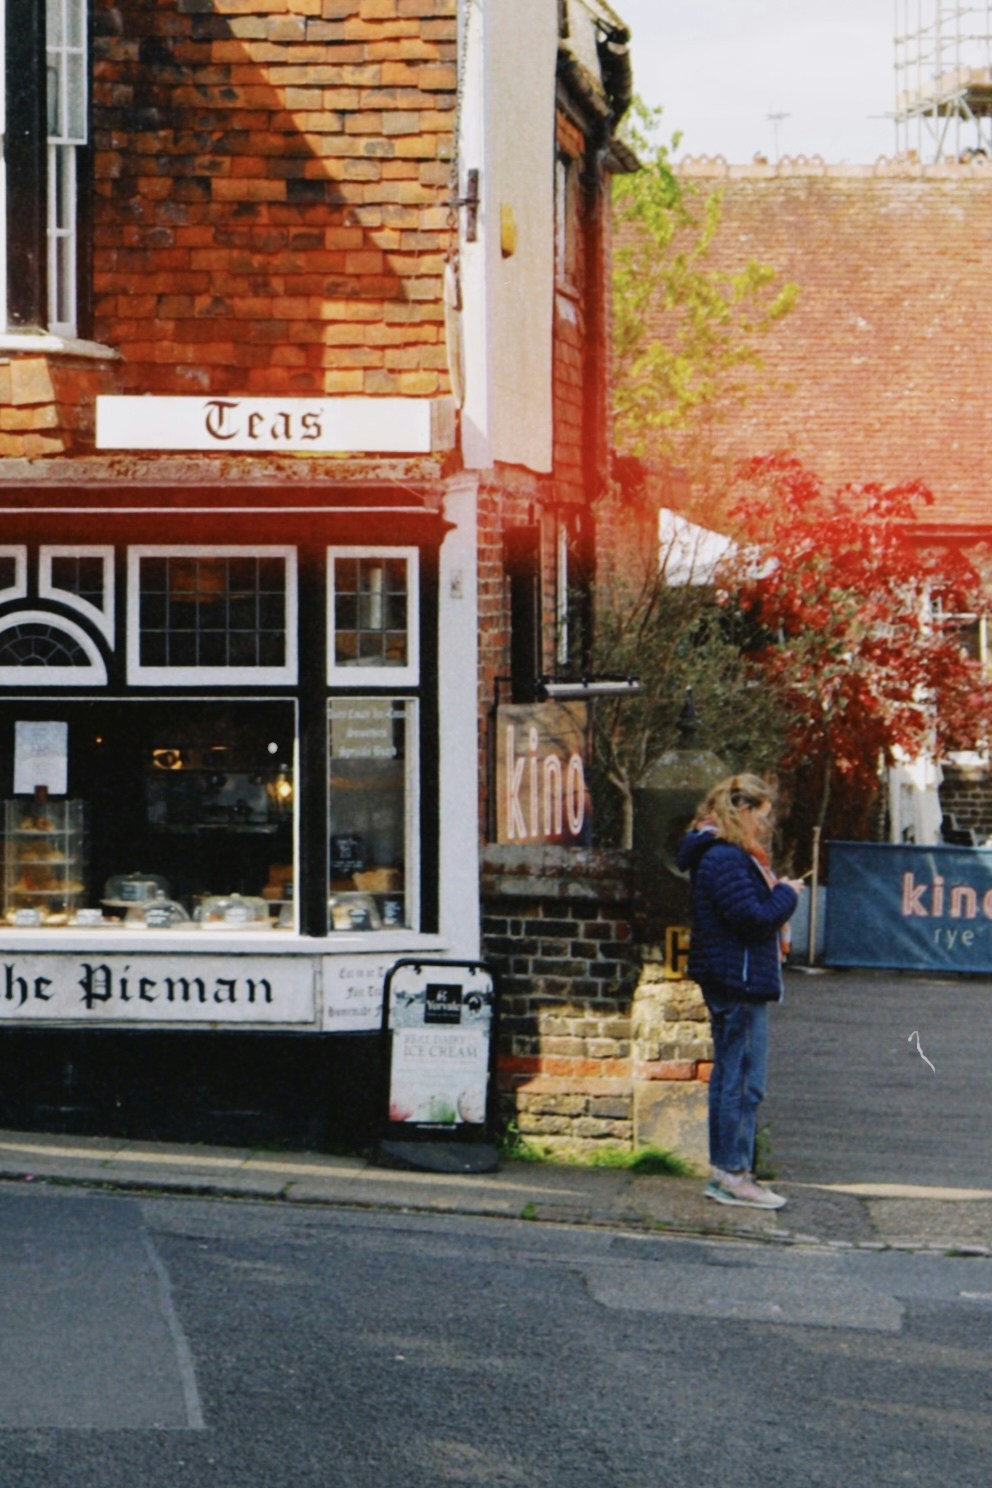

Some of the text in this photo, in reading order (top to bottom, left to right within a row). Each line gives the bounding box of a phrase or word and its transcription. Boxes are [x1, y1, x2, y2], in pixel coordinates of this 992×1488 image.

[203, 400, 324, 440] Teas
[507, 724, 586, 840] kino
[933, 928, 975, 950] rye
[78, 963, 275, 1009] Pieman
[429, 1046, 478, 1058] CREAM
